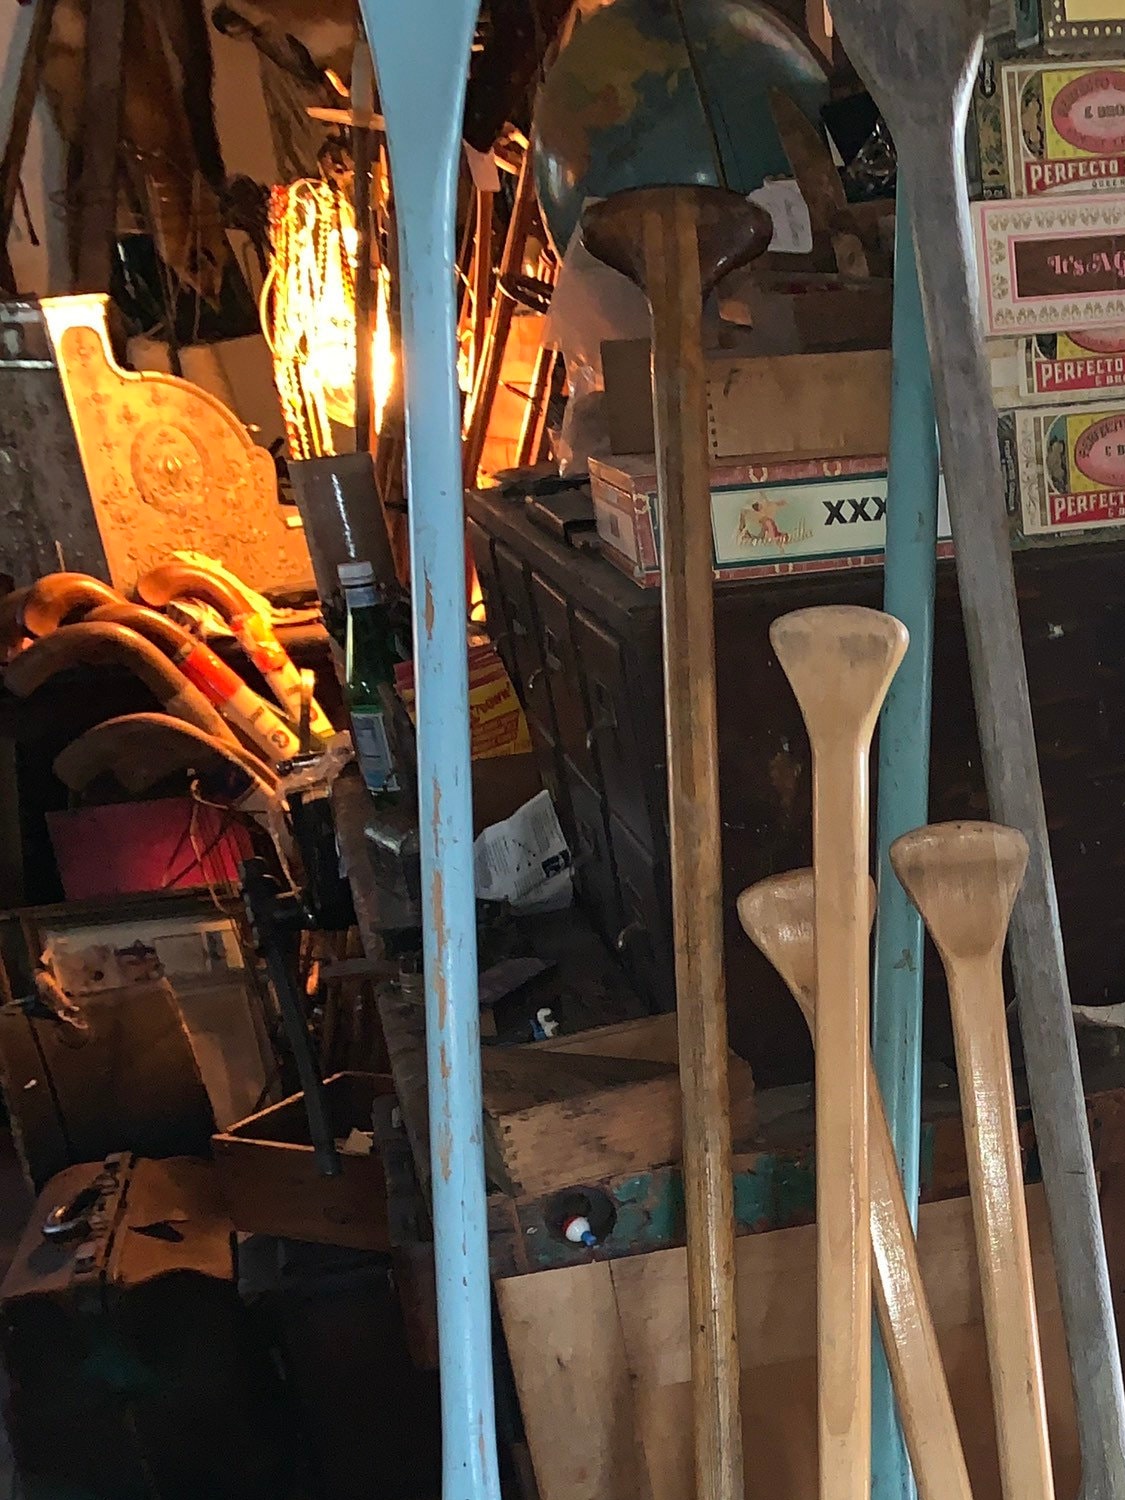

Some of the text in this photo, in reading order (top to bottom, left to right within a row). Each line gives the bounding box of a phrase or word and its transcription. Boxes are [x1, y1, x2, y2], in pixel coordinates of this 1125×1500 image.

[1030, 159, 1118, 190] PERFECTO
[1047, 254, 1084, 276] It's
[1041, 357, 1124, 388] PERFECTO
